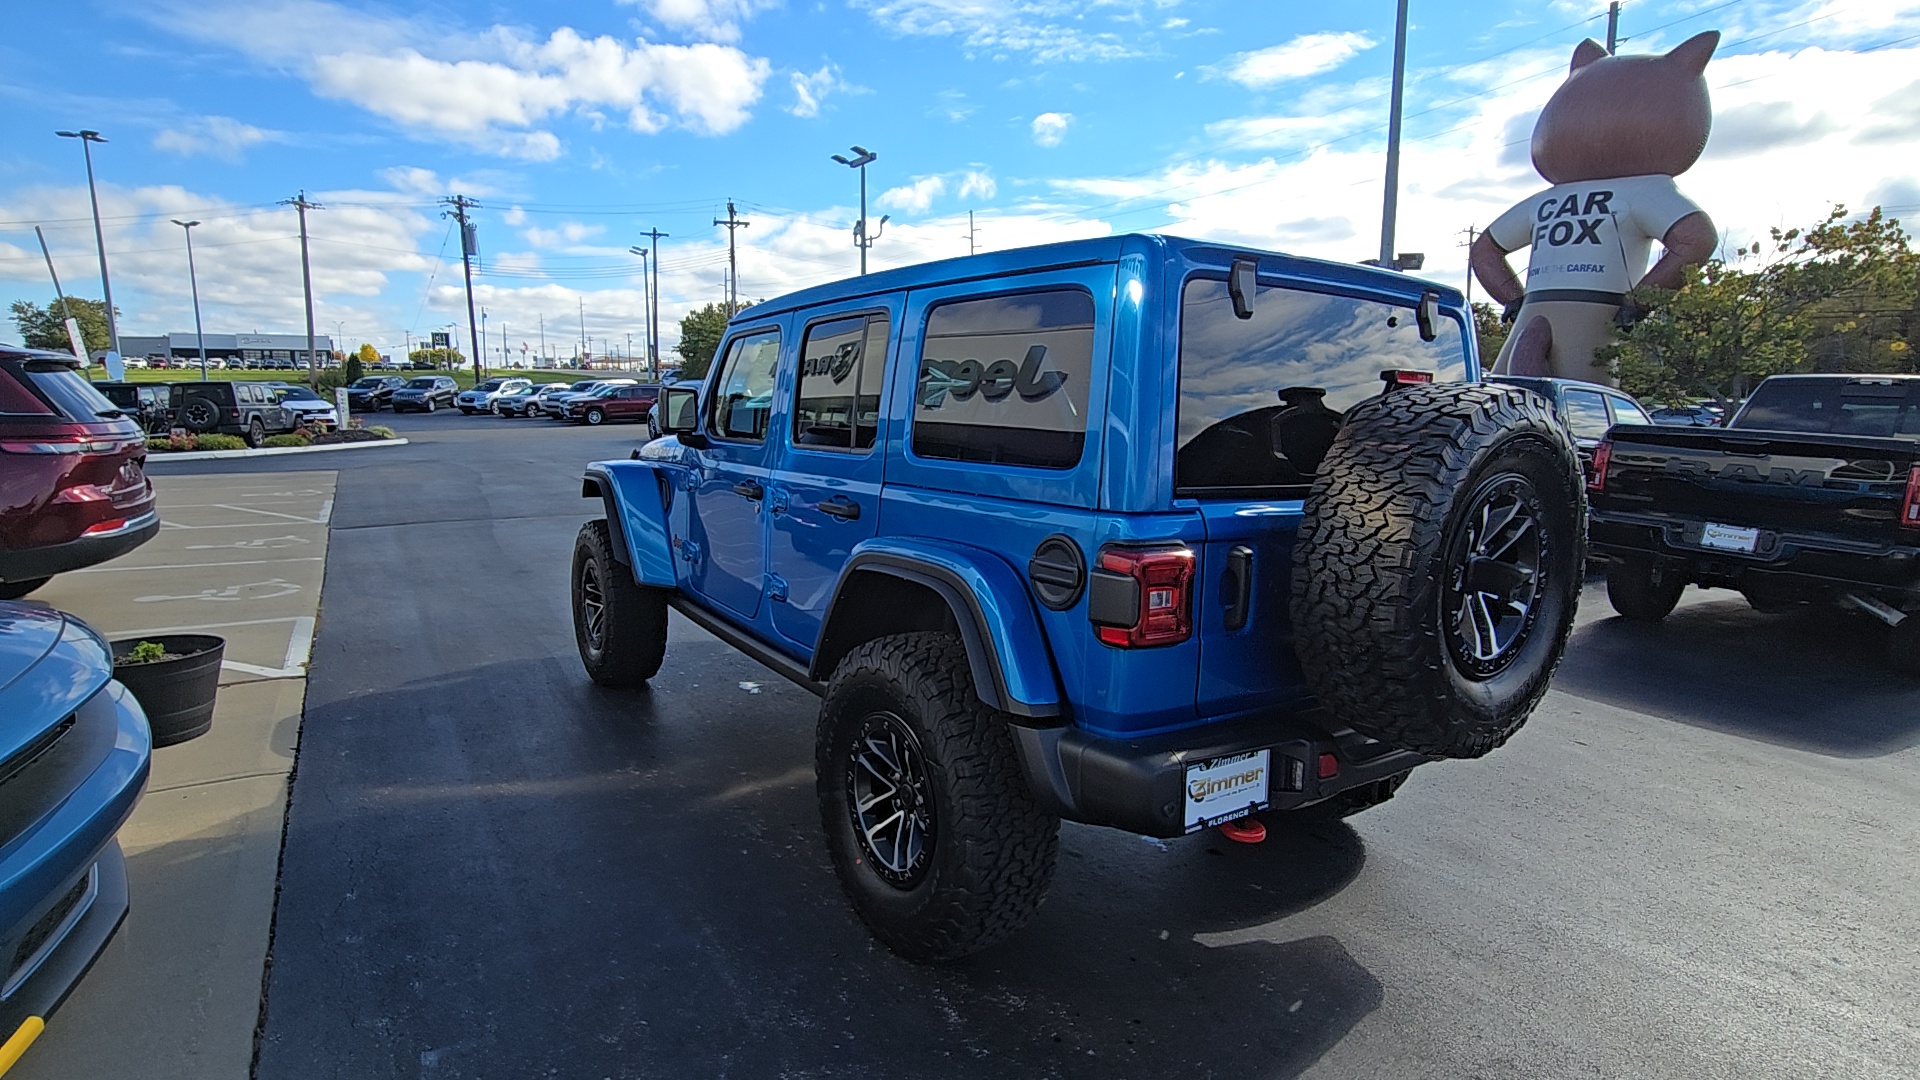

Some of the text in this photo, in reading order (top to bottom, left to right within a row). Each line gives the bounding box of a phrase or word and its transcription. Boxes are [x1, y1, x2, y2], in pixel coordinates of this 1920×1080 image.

[1537, 190, 1613, 222] CAR
[1534, 218, 1605, 251] FOX
[1567, 264, 1605, 273] CARFAX
[1666, 457, 1825, 487] RAM
[1209, 752, 1251, 769] Zimmer
[1190, 767, 1264, 799] Zimmer
[1208, 809, 1249, 828] FLORENCE
